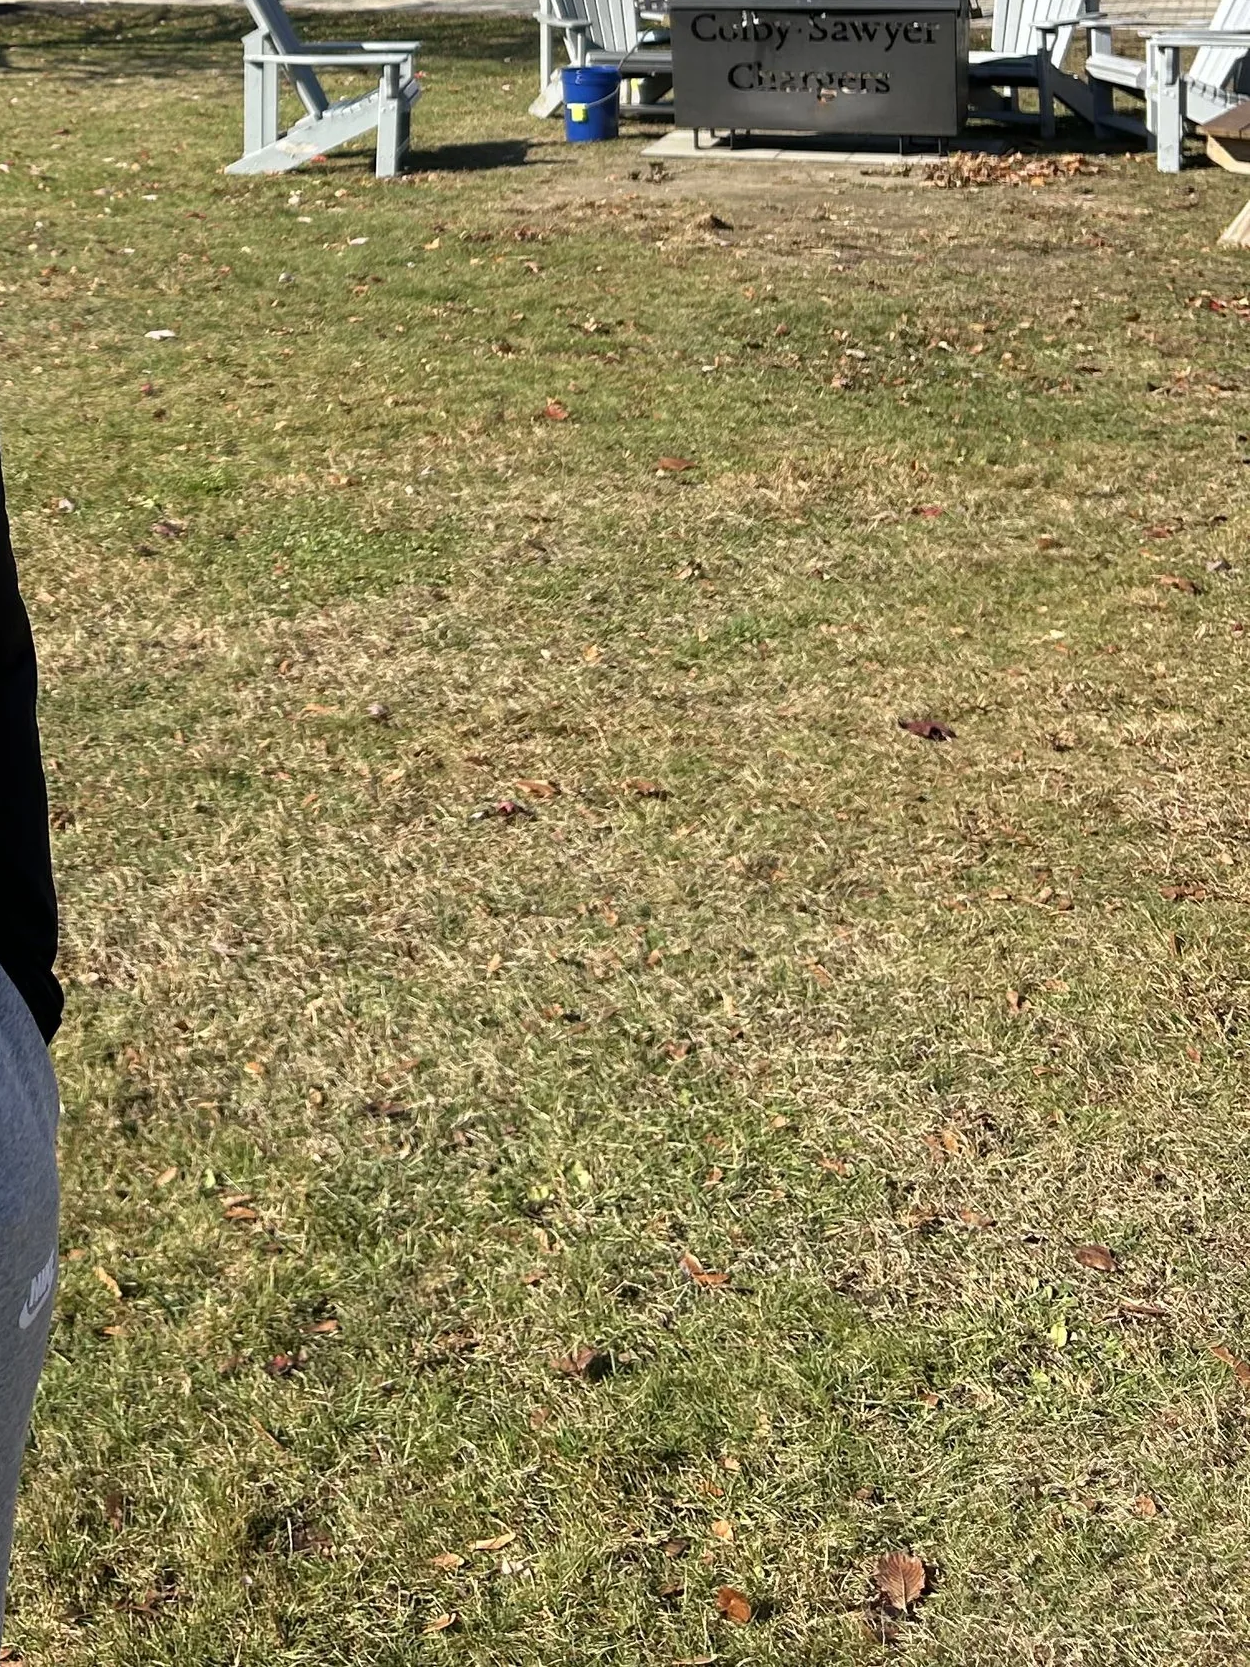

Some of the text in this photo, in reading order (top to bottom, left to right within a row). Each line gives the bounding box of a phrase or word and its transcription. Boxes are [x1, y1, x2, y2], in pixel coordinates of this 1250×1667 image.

[691, 10, 791, 51] Colby
[808, 12, 940, 52] Sawyer
[728, 61, 891, 102] Chargers
